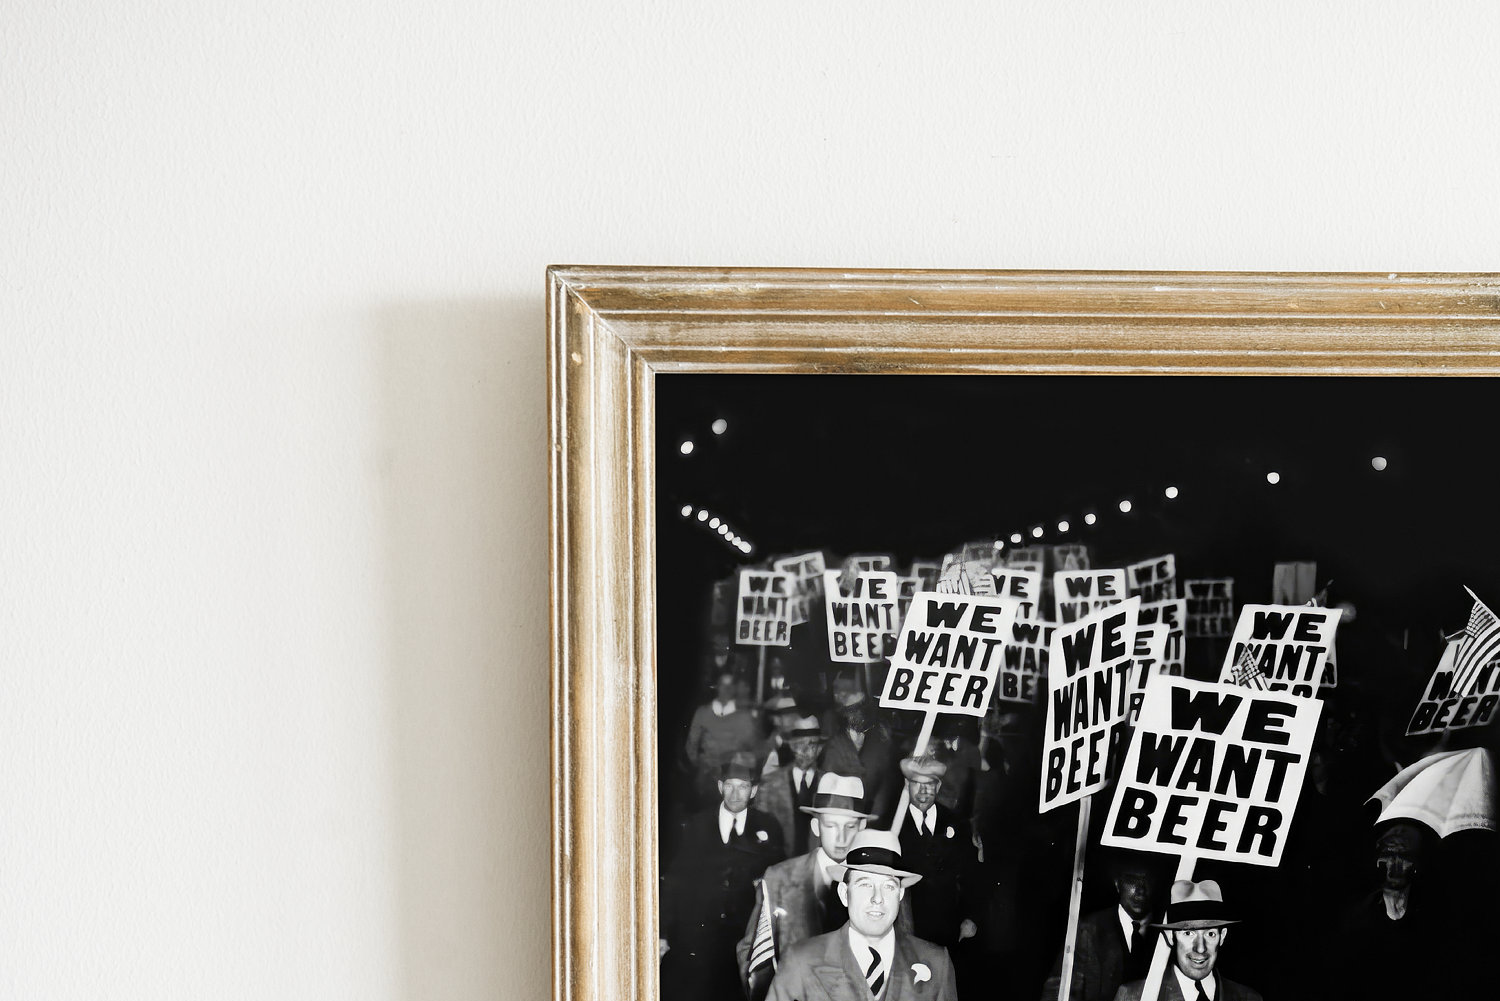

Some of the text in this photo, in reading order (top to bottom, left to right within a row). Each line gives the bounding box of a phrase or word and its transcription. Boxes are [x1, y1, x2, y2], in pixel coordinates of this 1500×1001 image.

[1065, 575, 1116, 597] WE
[739, 619, 788, 642] BEER
[831, 602, 894, 630] WANT
[926, 600, 1002, 634] WE
[1253, 611, 1327, 642] WE
[905, 630, 1002, 672] WANT
[1062, 611, 1126, 678] WE
[1133, 630, 1154, 655] E
[888, 668, 988, 709] BEER
[1002, 672, 1050, 700] BE
[1053, 660, 1132, 743] WANT
[1171, 686, 1297, 745] WE
[1408, 694, 1500, 733] BEER
[1136, 731, 1301, 803] WANT
[1111, 786, 1283, 858] BEER
